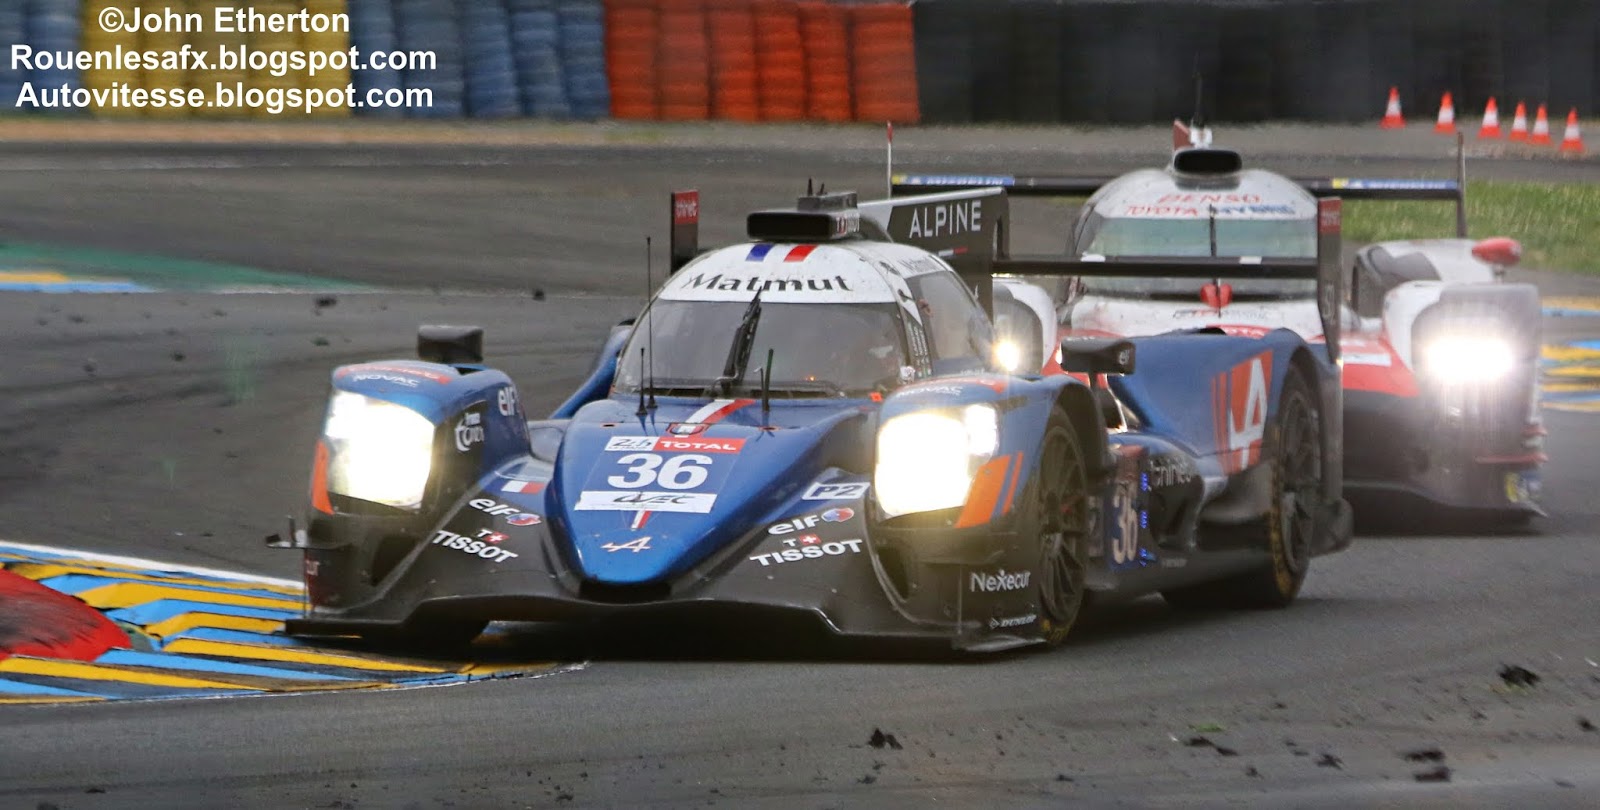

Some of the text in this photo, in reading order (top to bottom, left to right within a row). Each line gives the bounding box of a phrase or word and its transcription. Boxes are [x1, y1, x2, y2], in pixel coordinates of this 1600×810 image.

[908, 200, 982, 239] ALPINE
[681, 273, 854, 292] Matmut
[660, 441, 737, 450] TOTAL
[607, 453, 713, 490] 36
[811, 484, 864, 498] P2
[469, 498, 520, 516] elf
[768, 515, 819, 535] elf
[432, 530, 519, 563] TISSOT
[749, 539, 863, 566] TISSOT
